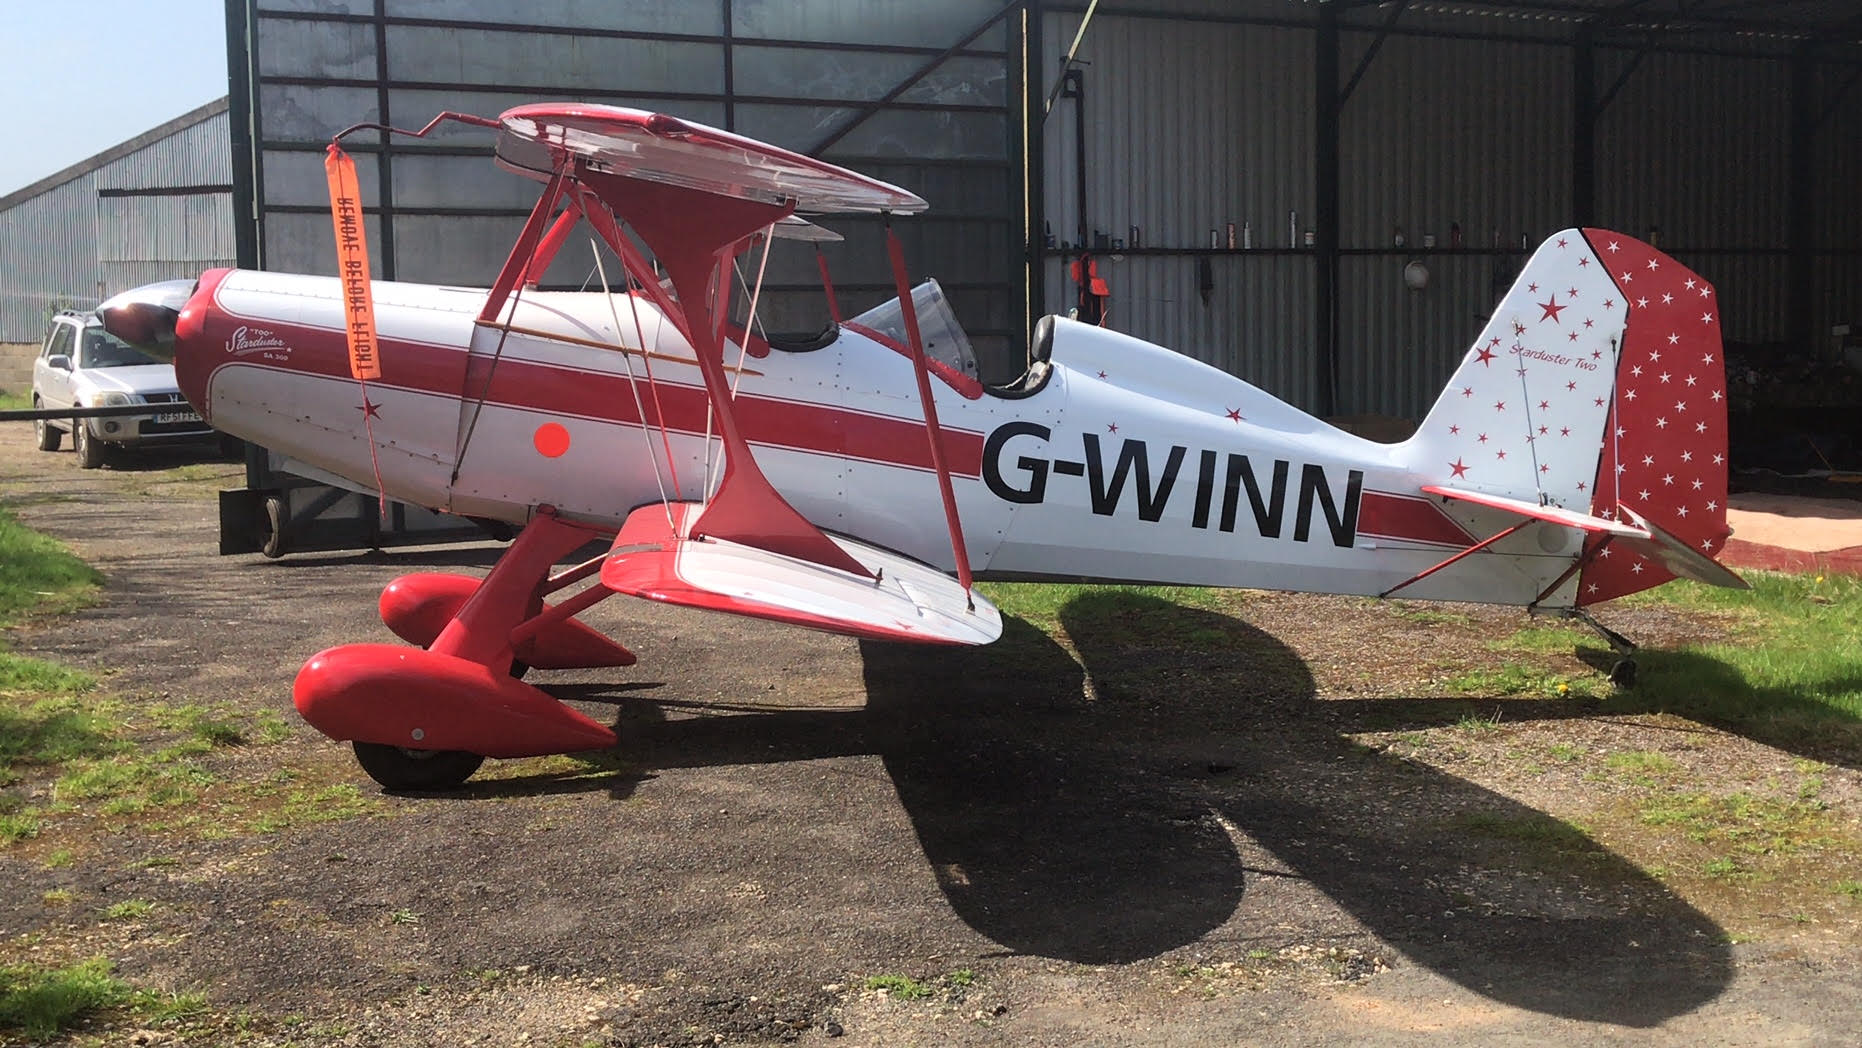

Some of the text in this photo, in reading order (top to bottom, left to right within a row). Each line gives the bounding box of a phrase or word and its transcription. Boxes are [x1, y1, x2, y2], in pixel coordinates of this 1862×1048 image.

[225, 325, 285, 352] Starduster
[1509, 344, 1598, 372] Starduster Two
[981, 421, 1364, 549] G-WINN
